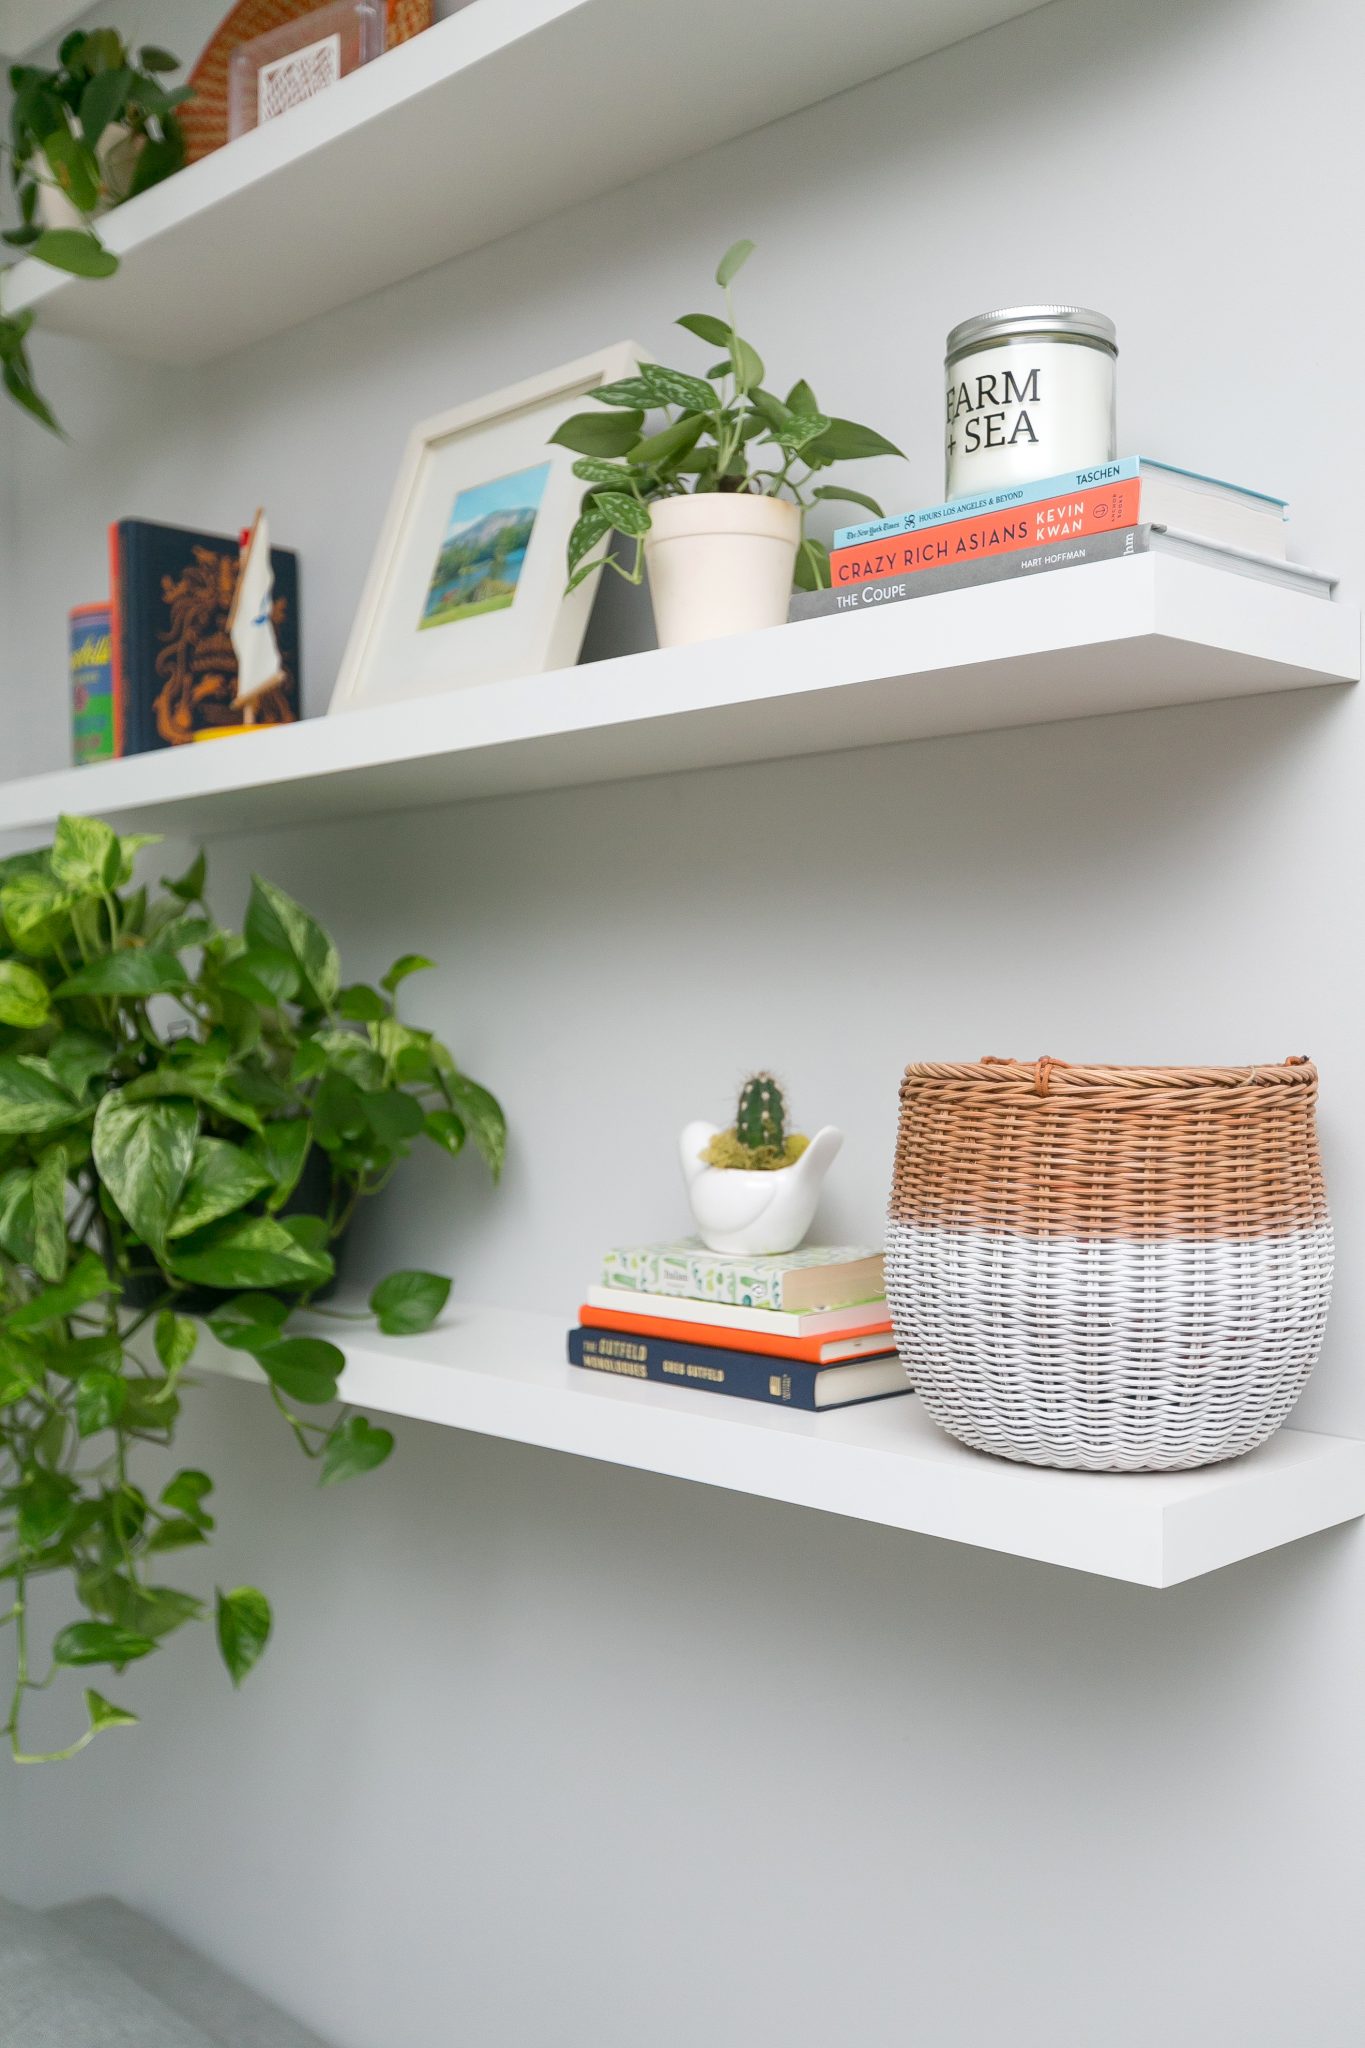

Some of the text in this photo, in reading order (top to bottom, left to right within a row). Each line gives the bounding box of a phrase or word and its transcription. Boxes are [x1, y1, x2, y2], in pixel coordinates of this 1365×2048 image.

[946, 368, 1041, 424] FARM
[965, 410, 1040, 453] SEA
[1076, 465, 1120, 485] TASCHEN
[918, 510, 942, 523] HOURS
[943, 507, 956, 517] LOS
[956, 499, 988, 514] ANGELES
[988, 497, 995, 505] &
[995, 490, 1024, 503] BEYOND
[1036, 502, 1084, 525] KEVIN
[857, 527, 870, 538] New
[868, 524, 883, 537] York
[883, 521, 900, 531] Times
[1036, 519, 1082, 541] KWAN
[838, 521, 1028, 581] CRAZY RICH ASIANS
[1123, 532, 1134, 556] hm
[1021, 549, 1086, 569] HART HOFFMAN
[836, 593, 859, 608] THE
